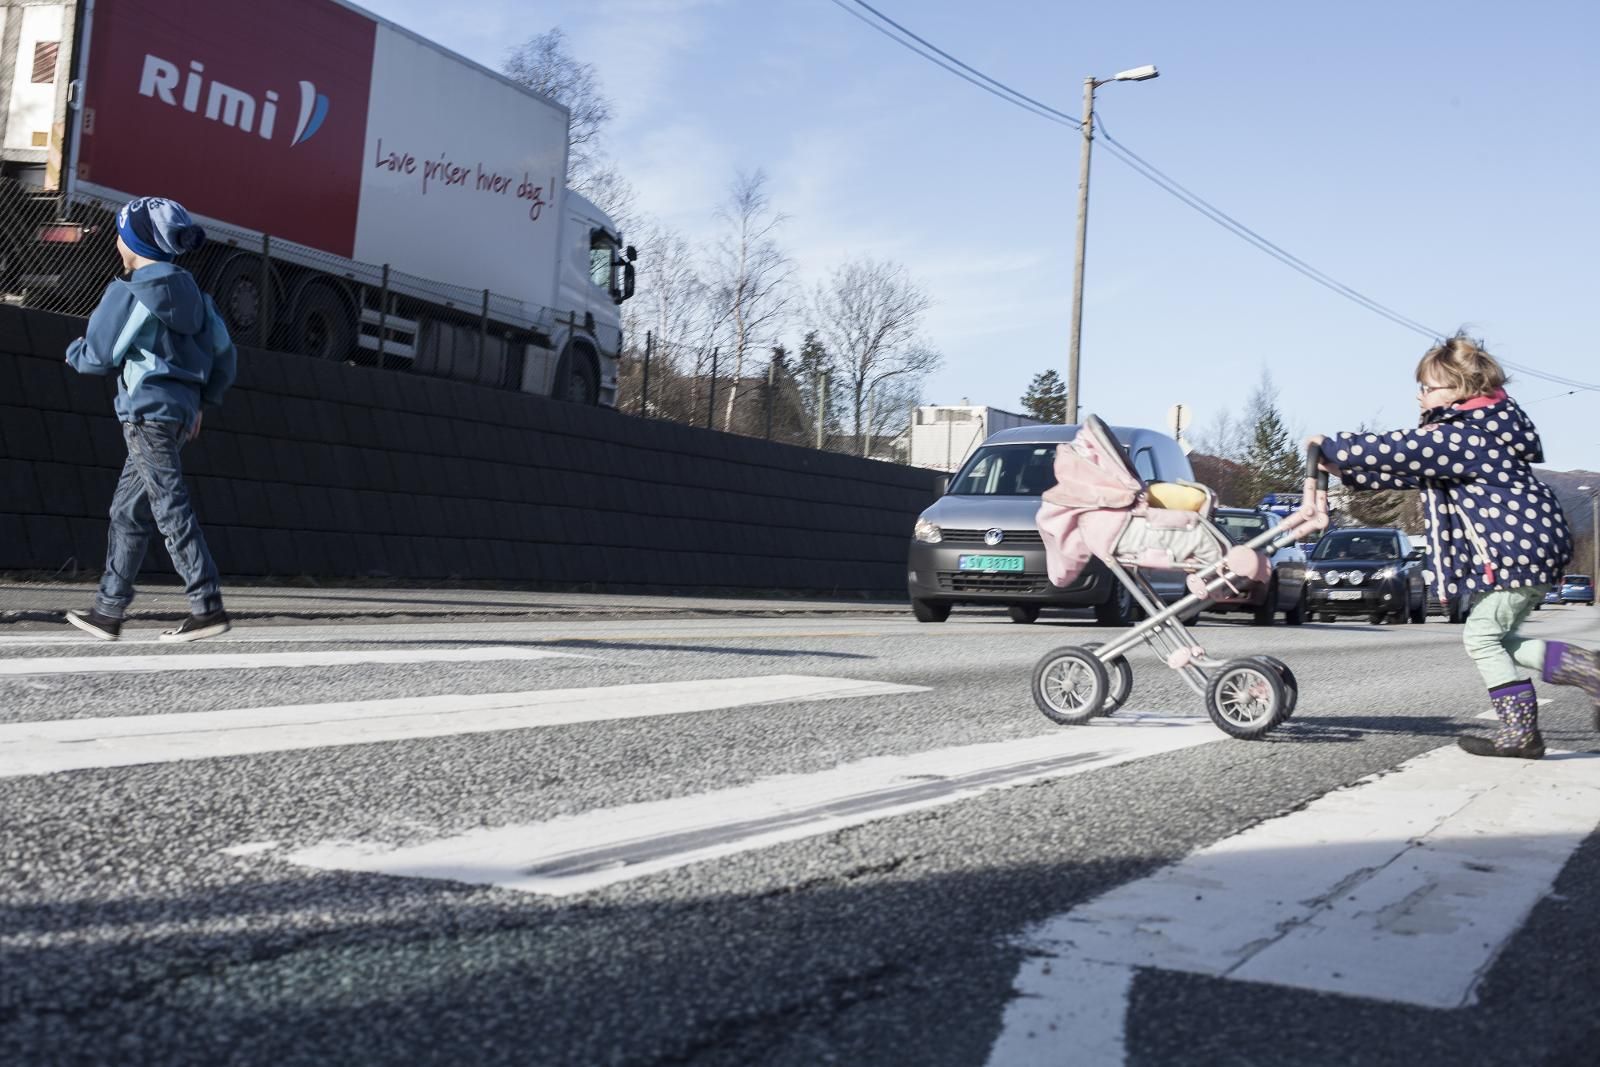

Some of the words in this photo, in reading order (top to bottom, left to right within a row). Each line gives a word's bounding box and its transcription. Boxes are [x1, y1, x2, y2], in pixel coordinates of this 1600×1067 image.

[138, 53, 279, 140] Rimi
[375, 138, 417, 175] Lave
[422, 152, 471, 195] priser
[476, 163, 512, 195] hver
